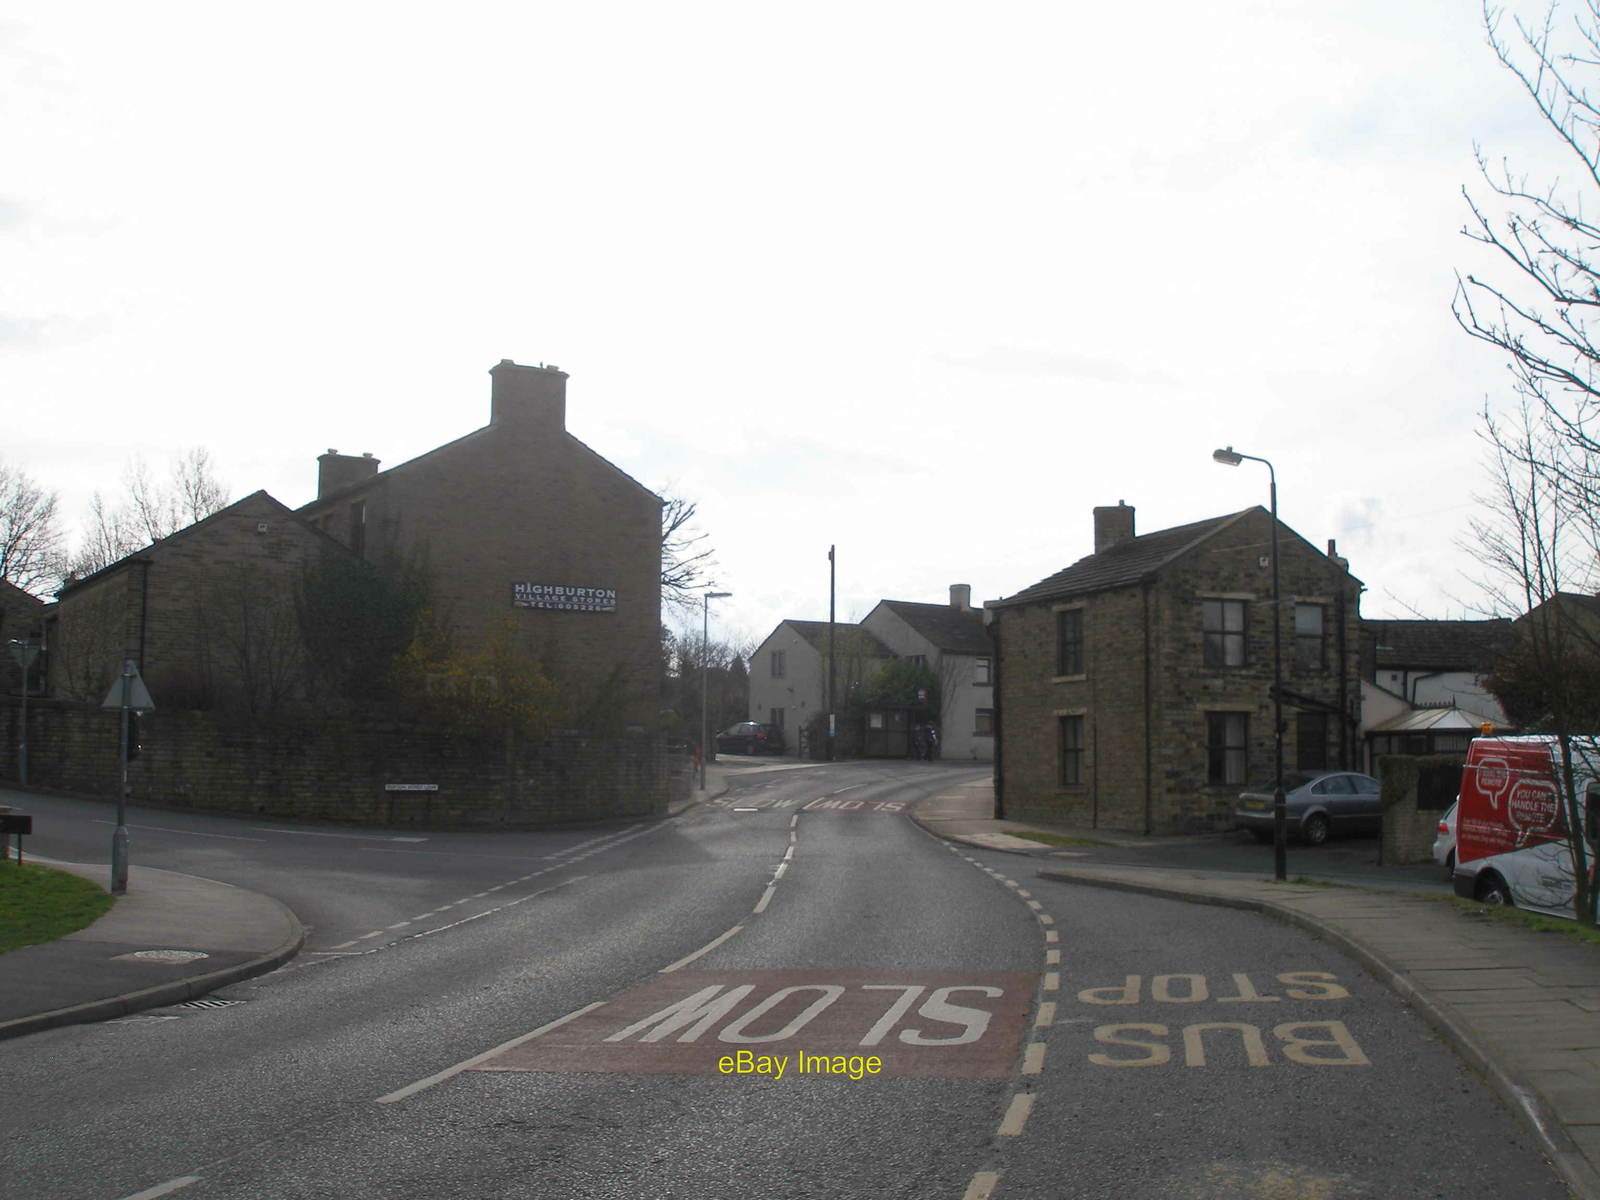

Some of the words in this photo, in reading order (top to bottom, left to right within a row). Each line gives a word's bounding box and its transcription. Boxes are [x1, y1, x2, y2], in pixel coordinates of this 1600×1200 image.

[515, 593, 566, 601] VILLAGE
[572, 597, 616, 605] STORES
[1516, 788, 1531, 798] YOU
[815, 801, 906, 811] SLOW
[1511, 800, 1539, 812] HANDLE
[1540, 802, 1555, 813] THE
[1077, 971, 1350, 1005] STOP
[602, 984, 1004, 1047] SLOW
[1087, 1020, 1372, 1067] BUS
